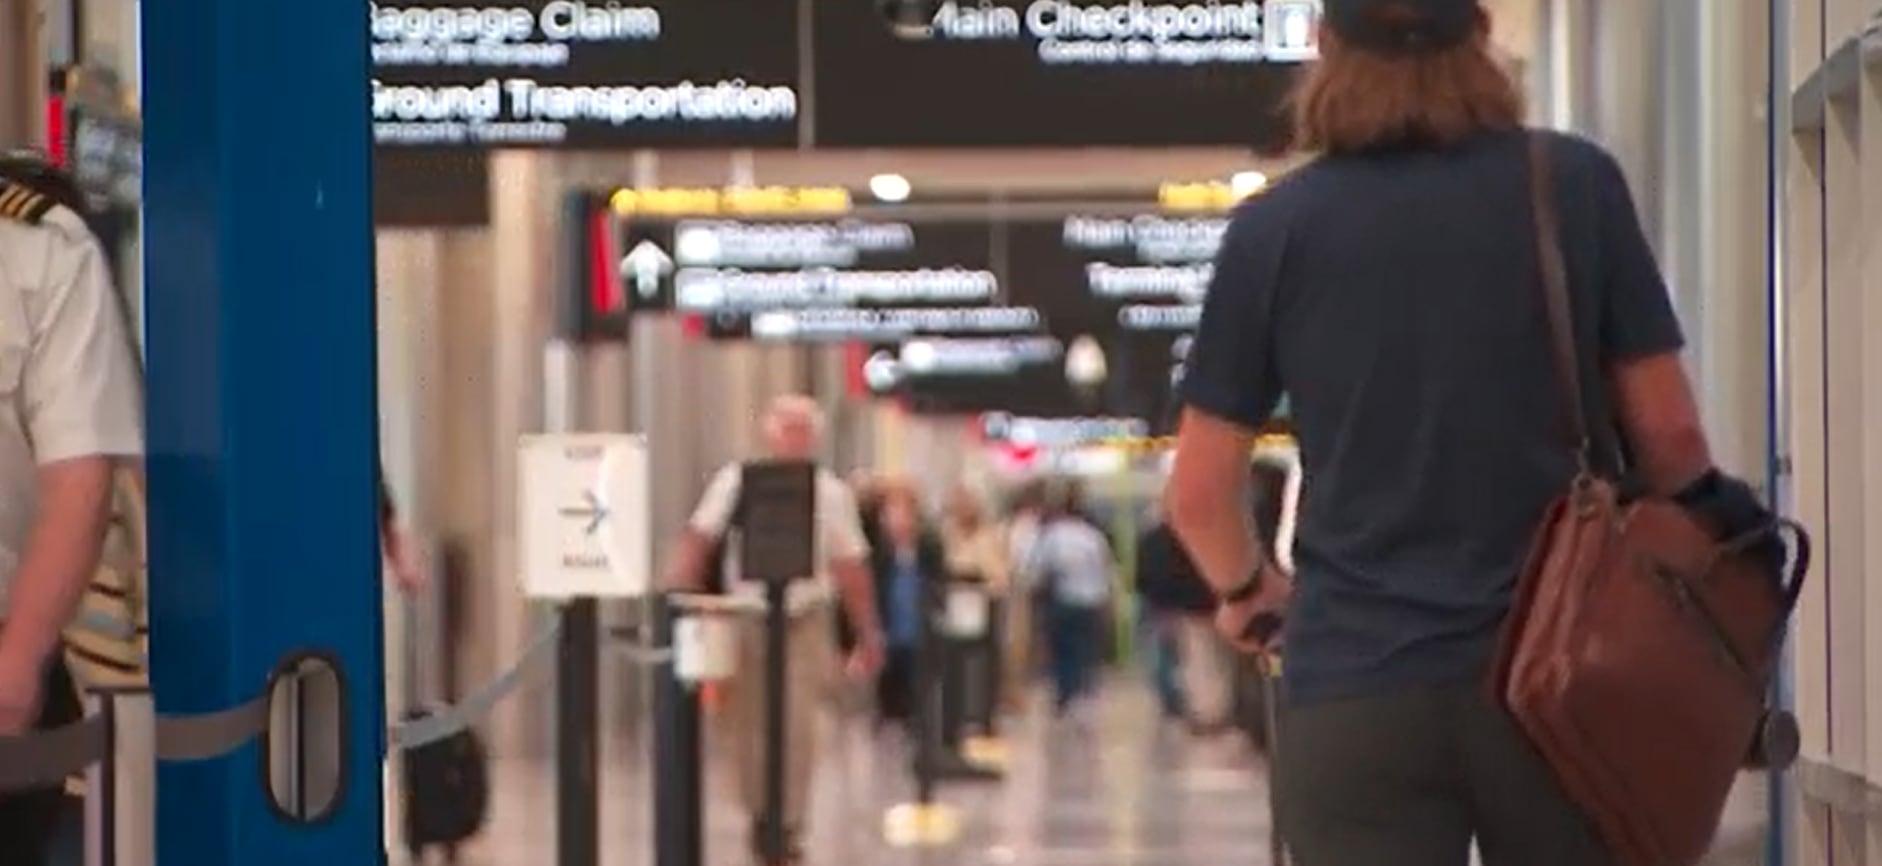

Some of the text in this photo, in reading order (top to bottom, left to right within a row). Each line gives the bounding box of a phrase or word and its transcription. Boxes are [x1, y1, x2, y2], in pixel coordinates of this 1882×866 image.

[370, 0, 660, 43] aggage Claim
[1025, 0, 1259, 41] Checkpoint
[371, 77, 796, 125] round Transportation
